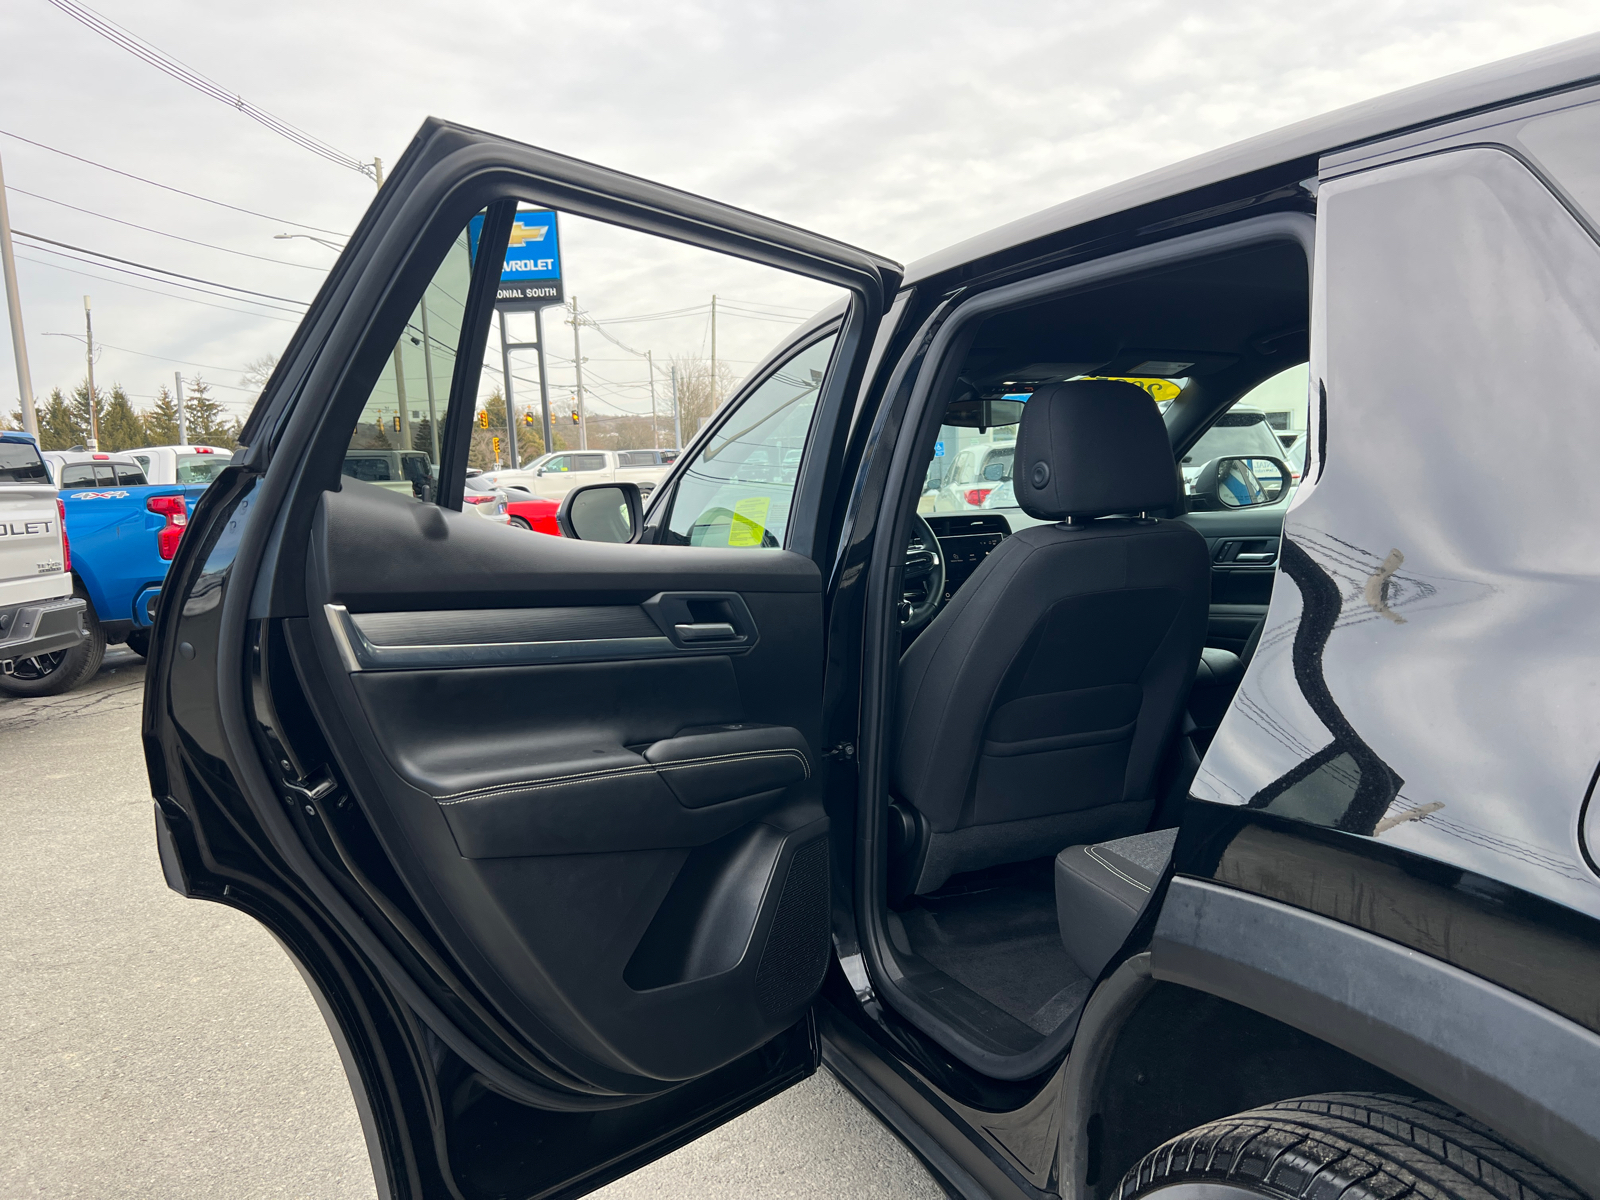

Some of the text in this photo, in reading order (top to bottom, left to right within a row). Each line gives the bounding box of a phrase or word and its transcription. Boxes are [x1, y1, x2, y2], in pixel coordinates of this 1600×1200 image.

[502, 259, 554, 271] VROLET
[496, 287, 557, 299] ONIAL SOUTH
